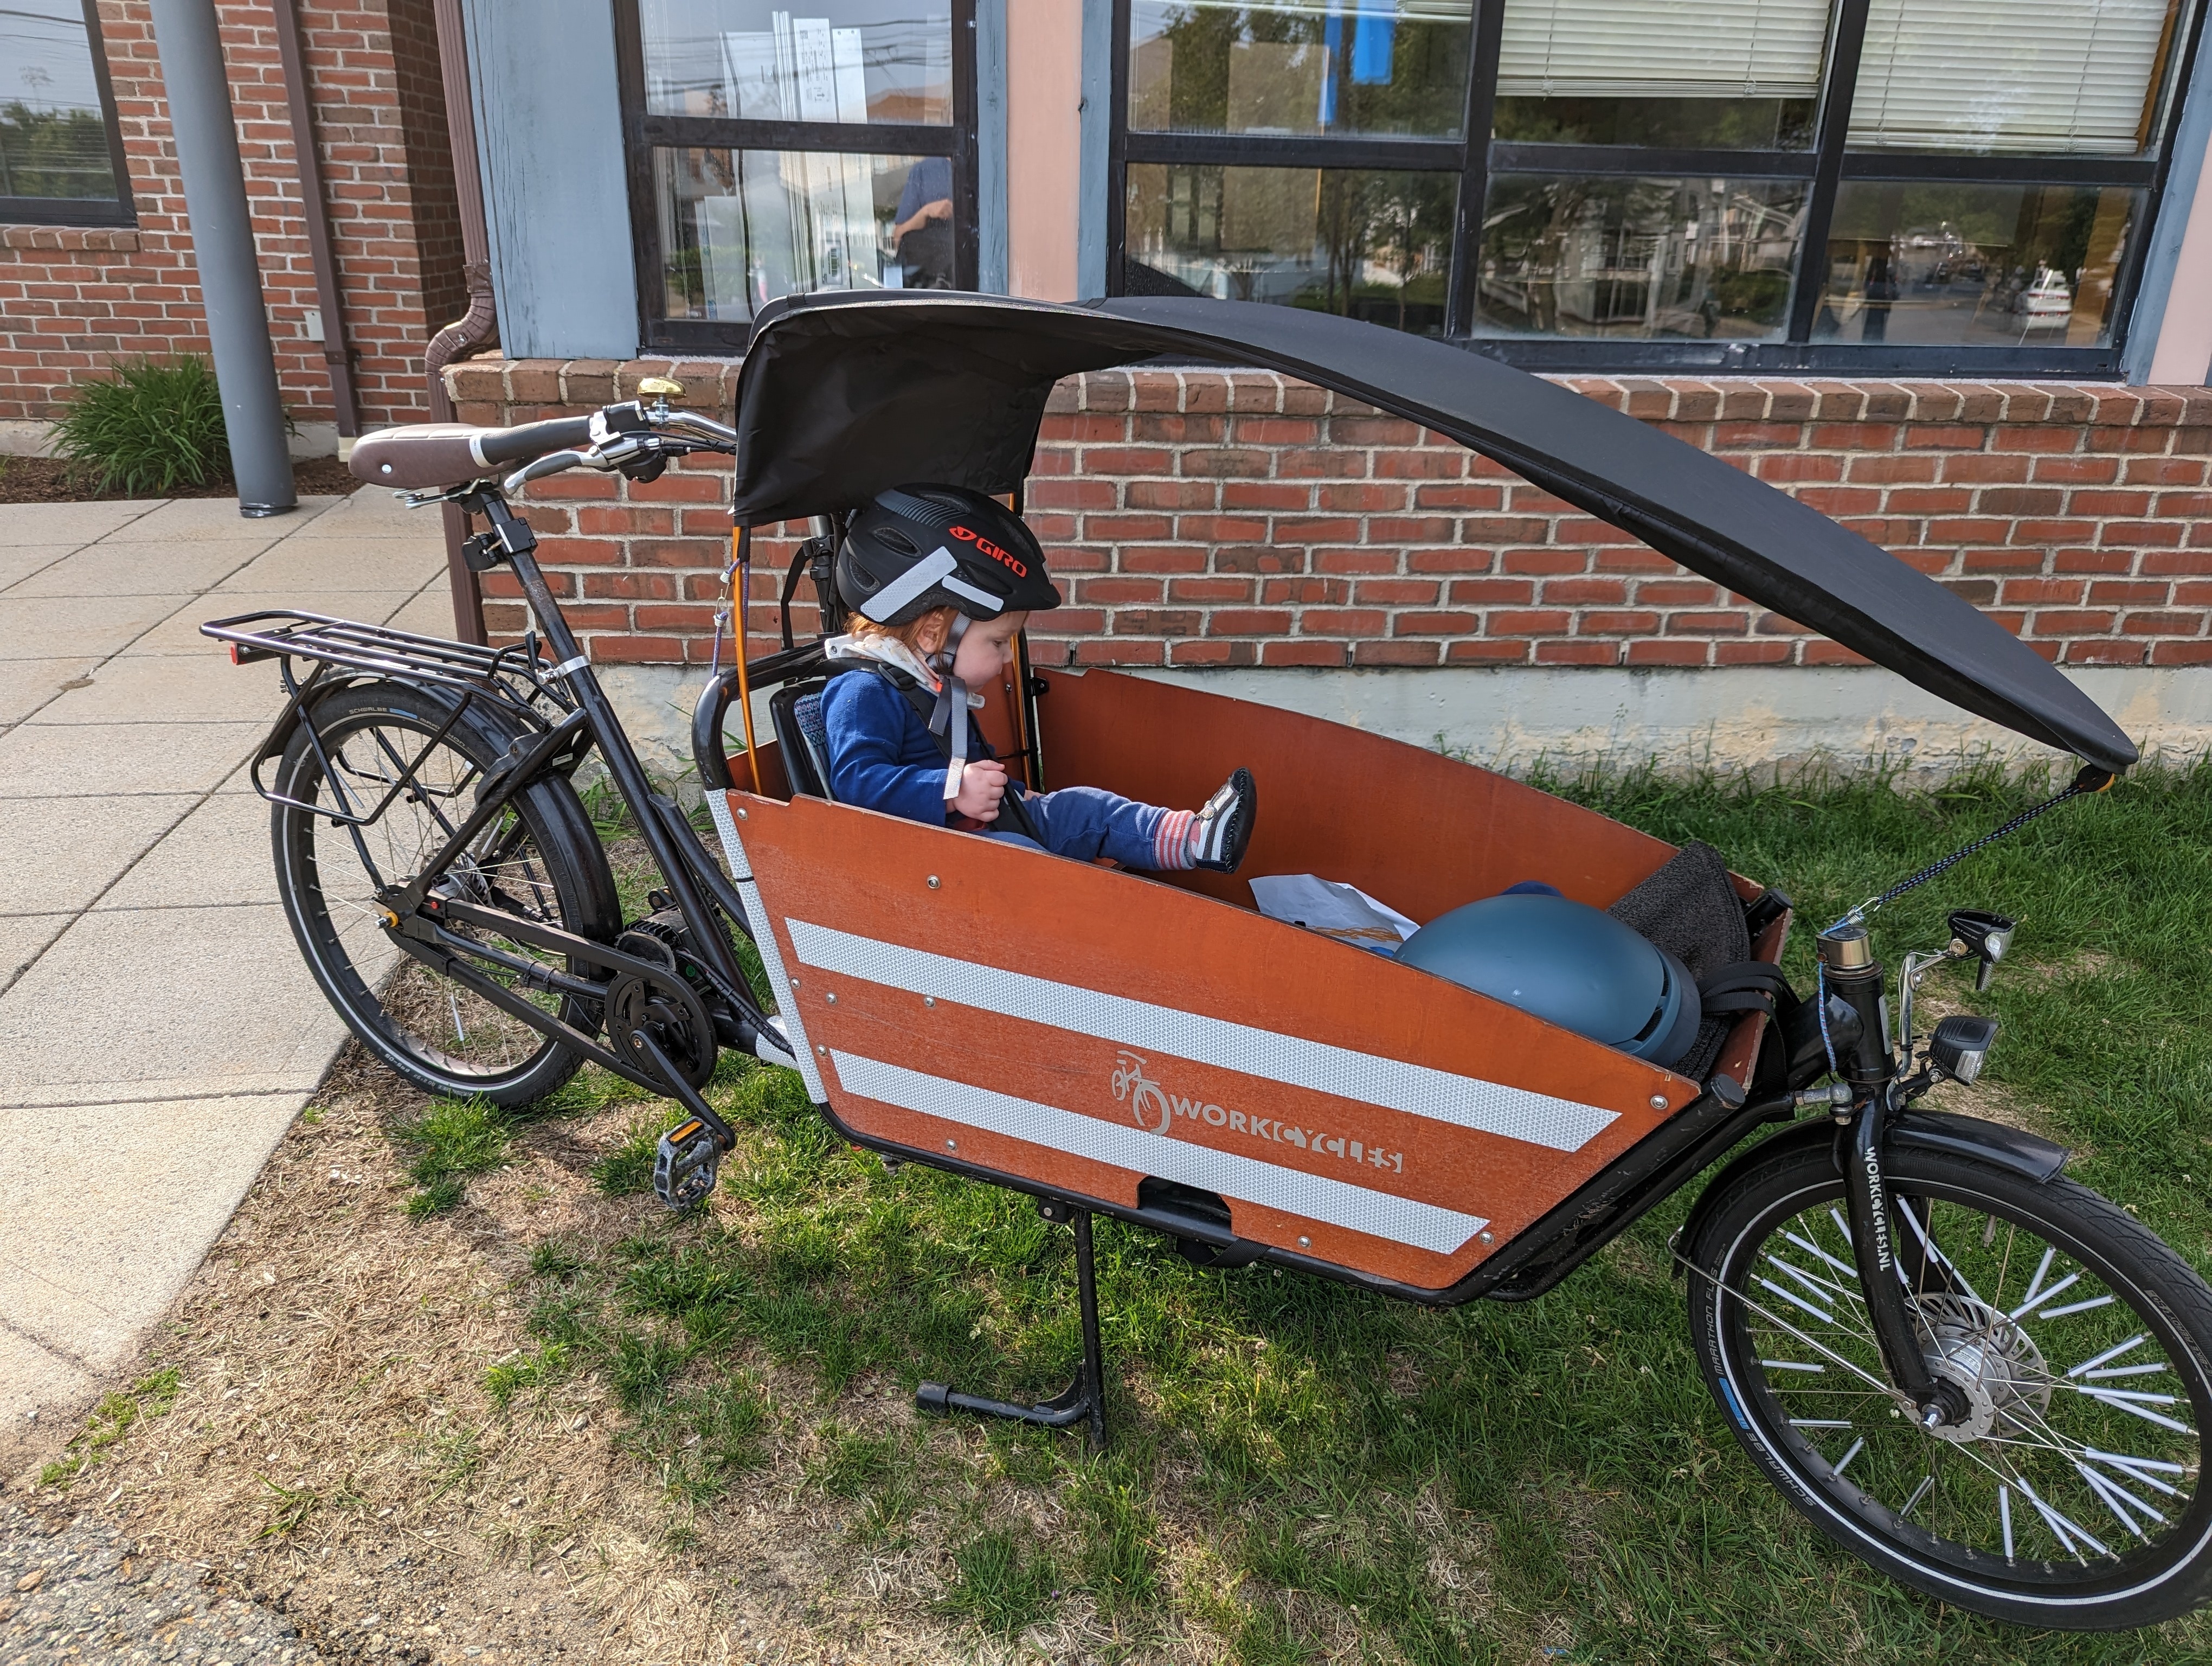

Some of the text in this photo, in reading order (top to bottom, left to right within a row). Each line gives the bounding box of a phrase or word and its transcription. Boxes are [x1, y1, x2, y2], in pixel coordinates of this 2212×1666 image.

[976, 537, 1027, 578] GIRO
[349, 707, 388, 715] SCHWALBE
[420, 717, 466, 747] MARAHON
[1170, 1094, 1403, 1174] WORKCYCLES
[1864, 1145, 1892, 1272] WORKCYCLES.NL
[1705, 1305, 1725, 1375] MARATHON
[1745, 1432, 1817, 1507] SCHWALBE
